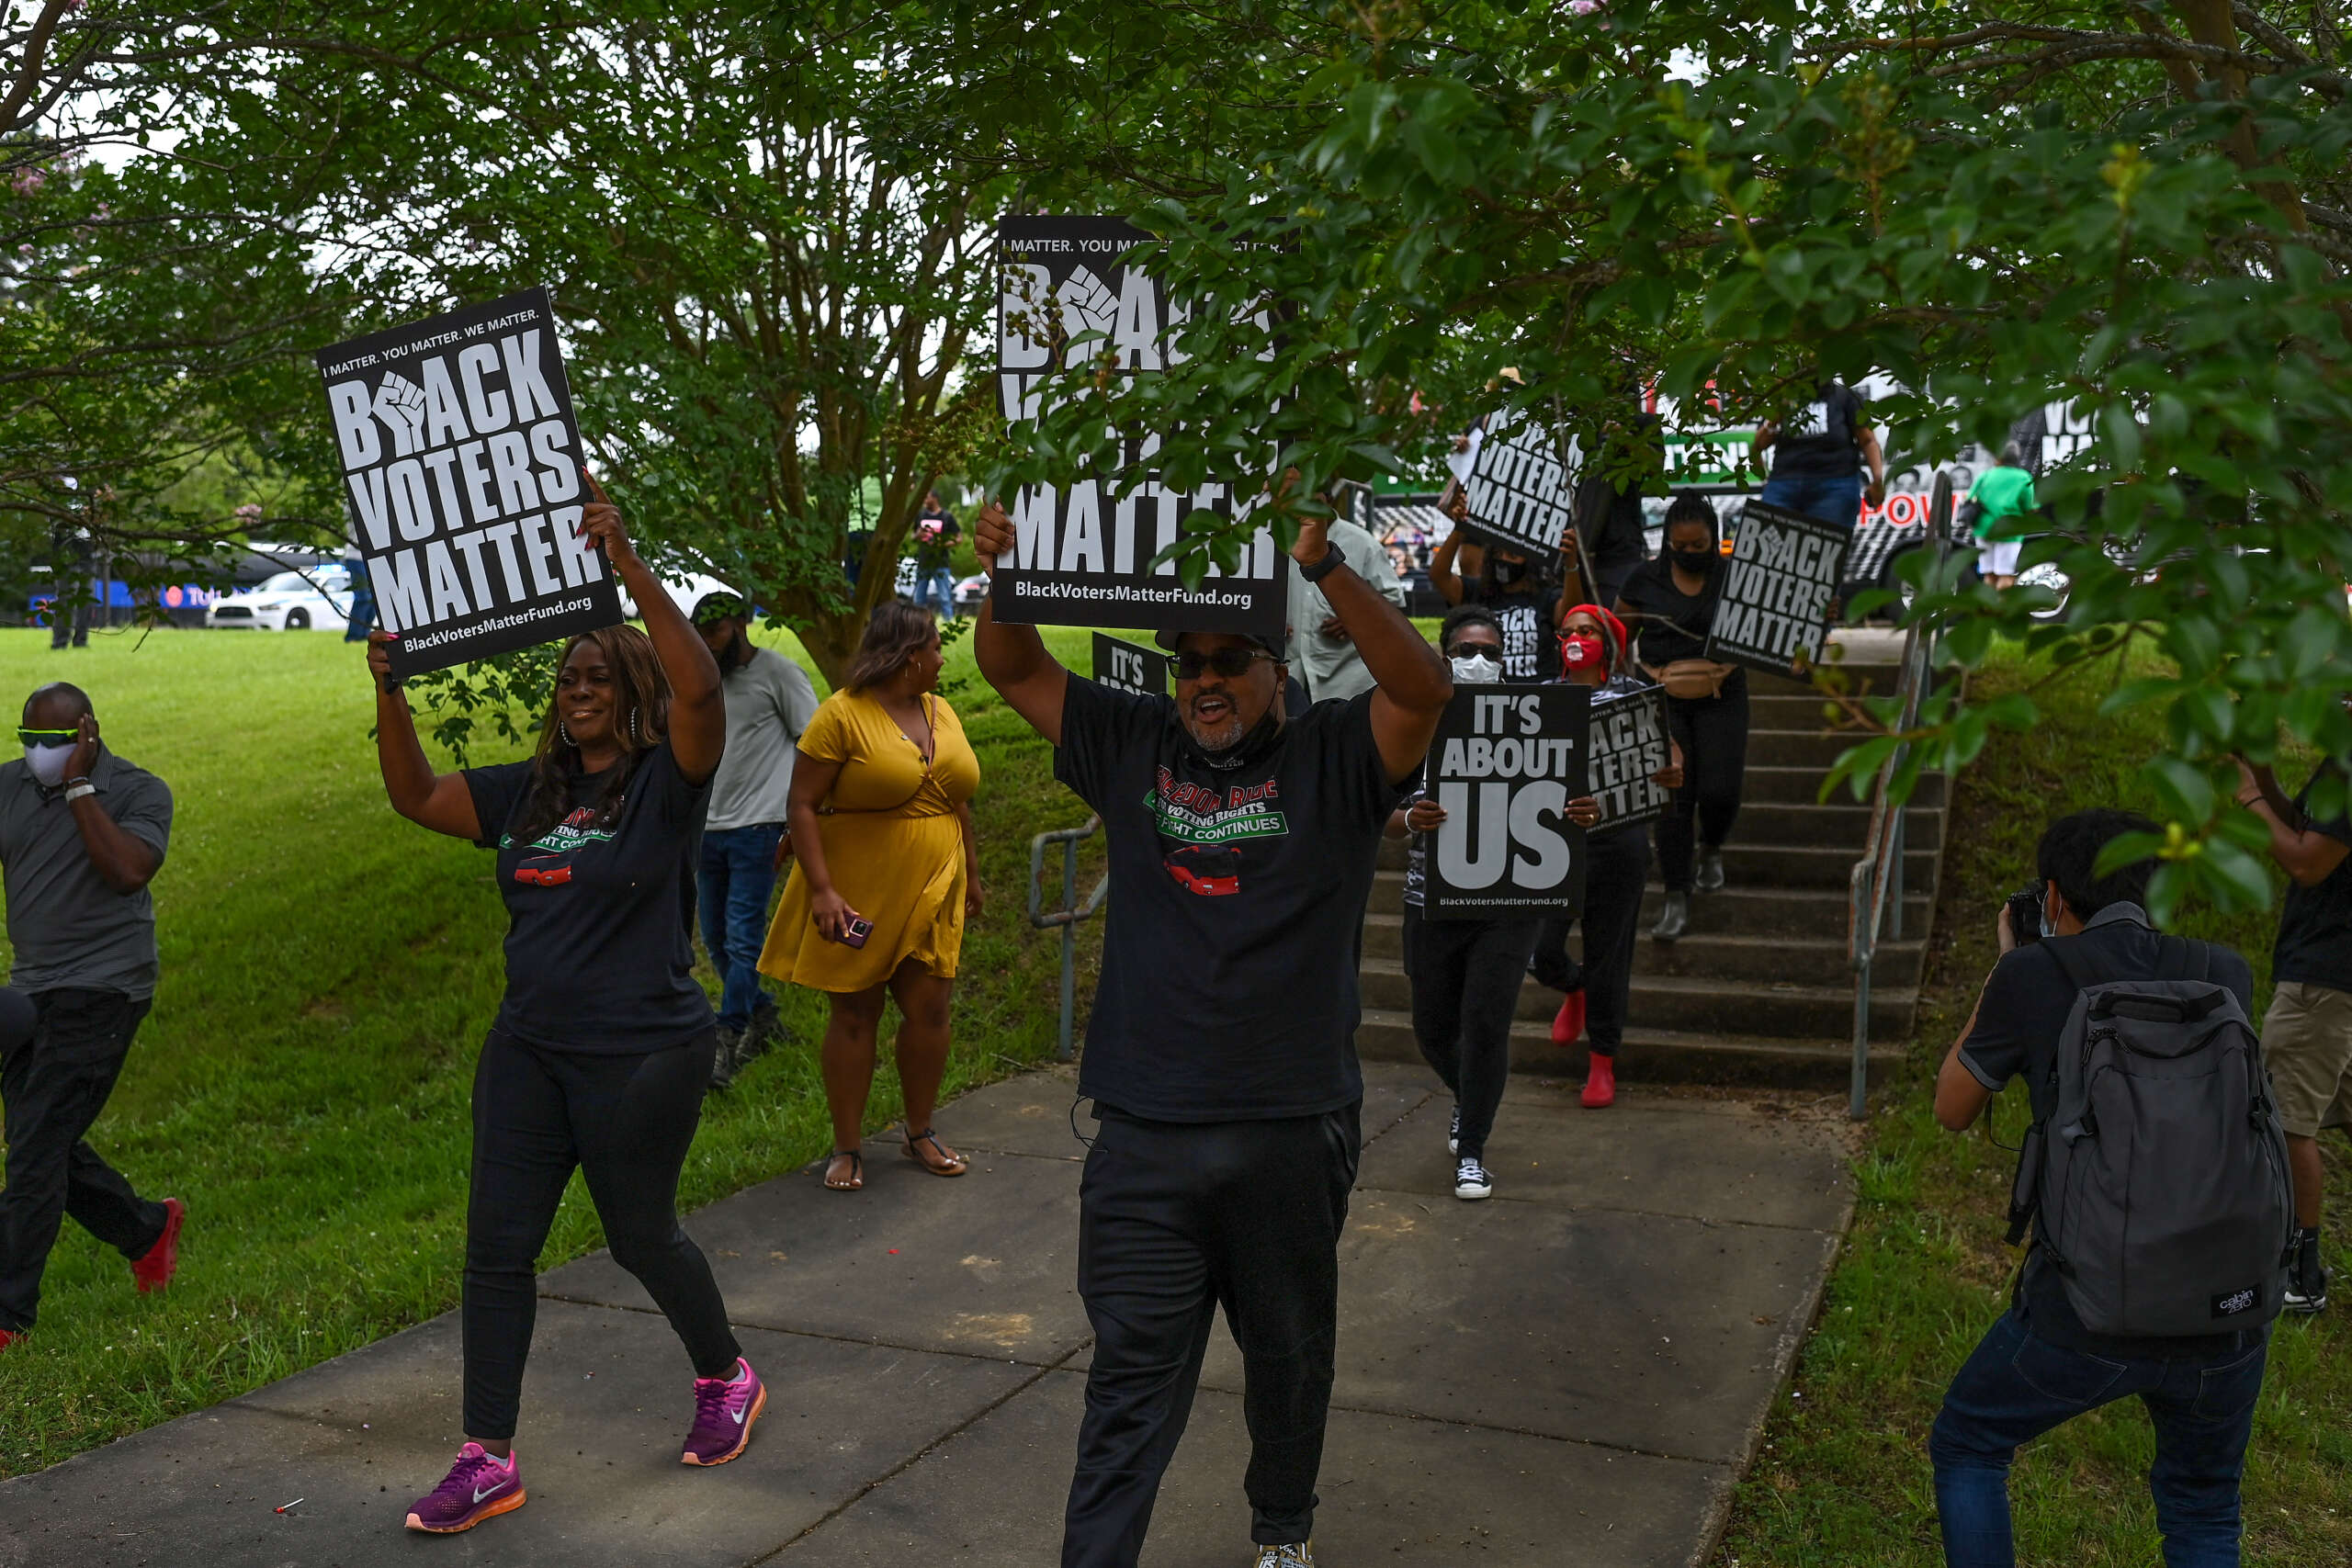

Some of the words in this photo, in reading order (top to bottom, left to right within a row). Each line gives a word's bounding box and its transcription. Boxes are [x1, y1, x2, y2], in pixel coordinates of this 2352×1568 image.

[1011, 240, 1074, 253] MATTER.
[1079, 240, 1112, 253] YOU
[322, 367, 328, 378] I
[329, 354, 380, 378] MATTER.
[381, 346, 409, 361] YOU
[412, 331, 462, 353] MATTER.
[464, 323, 485, 338] WE
[487, 309, 539, 332] MATTER.
[347, 420, 581, 550] VOTERS
[1466, 475, 1568, 549] MATTER
[368, 504, 603, 634] MATTER
[1015, 581, 1251, 609] BlackVotersMatterFund.org
[1726, 559, 1833, 624] VOTERS
[404, 597, 593, 653] BlackVotersMatterFund.org
[1502, 631, 1538, 655] ERS
[1713, 599, 1822, 665] MATTER
[1111, 646, 1144, 687] IT'S
[1501, 654, 1538, 677] TER
[1474, 694, 1542, 735] IT'S
[1589, 702, 1663, 760] ACK
[1440, 738, 1573, 778] ABOUT
[1588, 740, 1667, 792] TERS
[1167, 805, 1215, 827] VOTING
[1216, 802, 1266, 823] RIGHTS
[1194, 818, 1280, 840] CONTINUES
[1437, 780, 1570, 890] US
[1440, 897, 1568, 908] BlackVotersMatterFund.org
[2220, 1290, 2254, 1309] cabin
